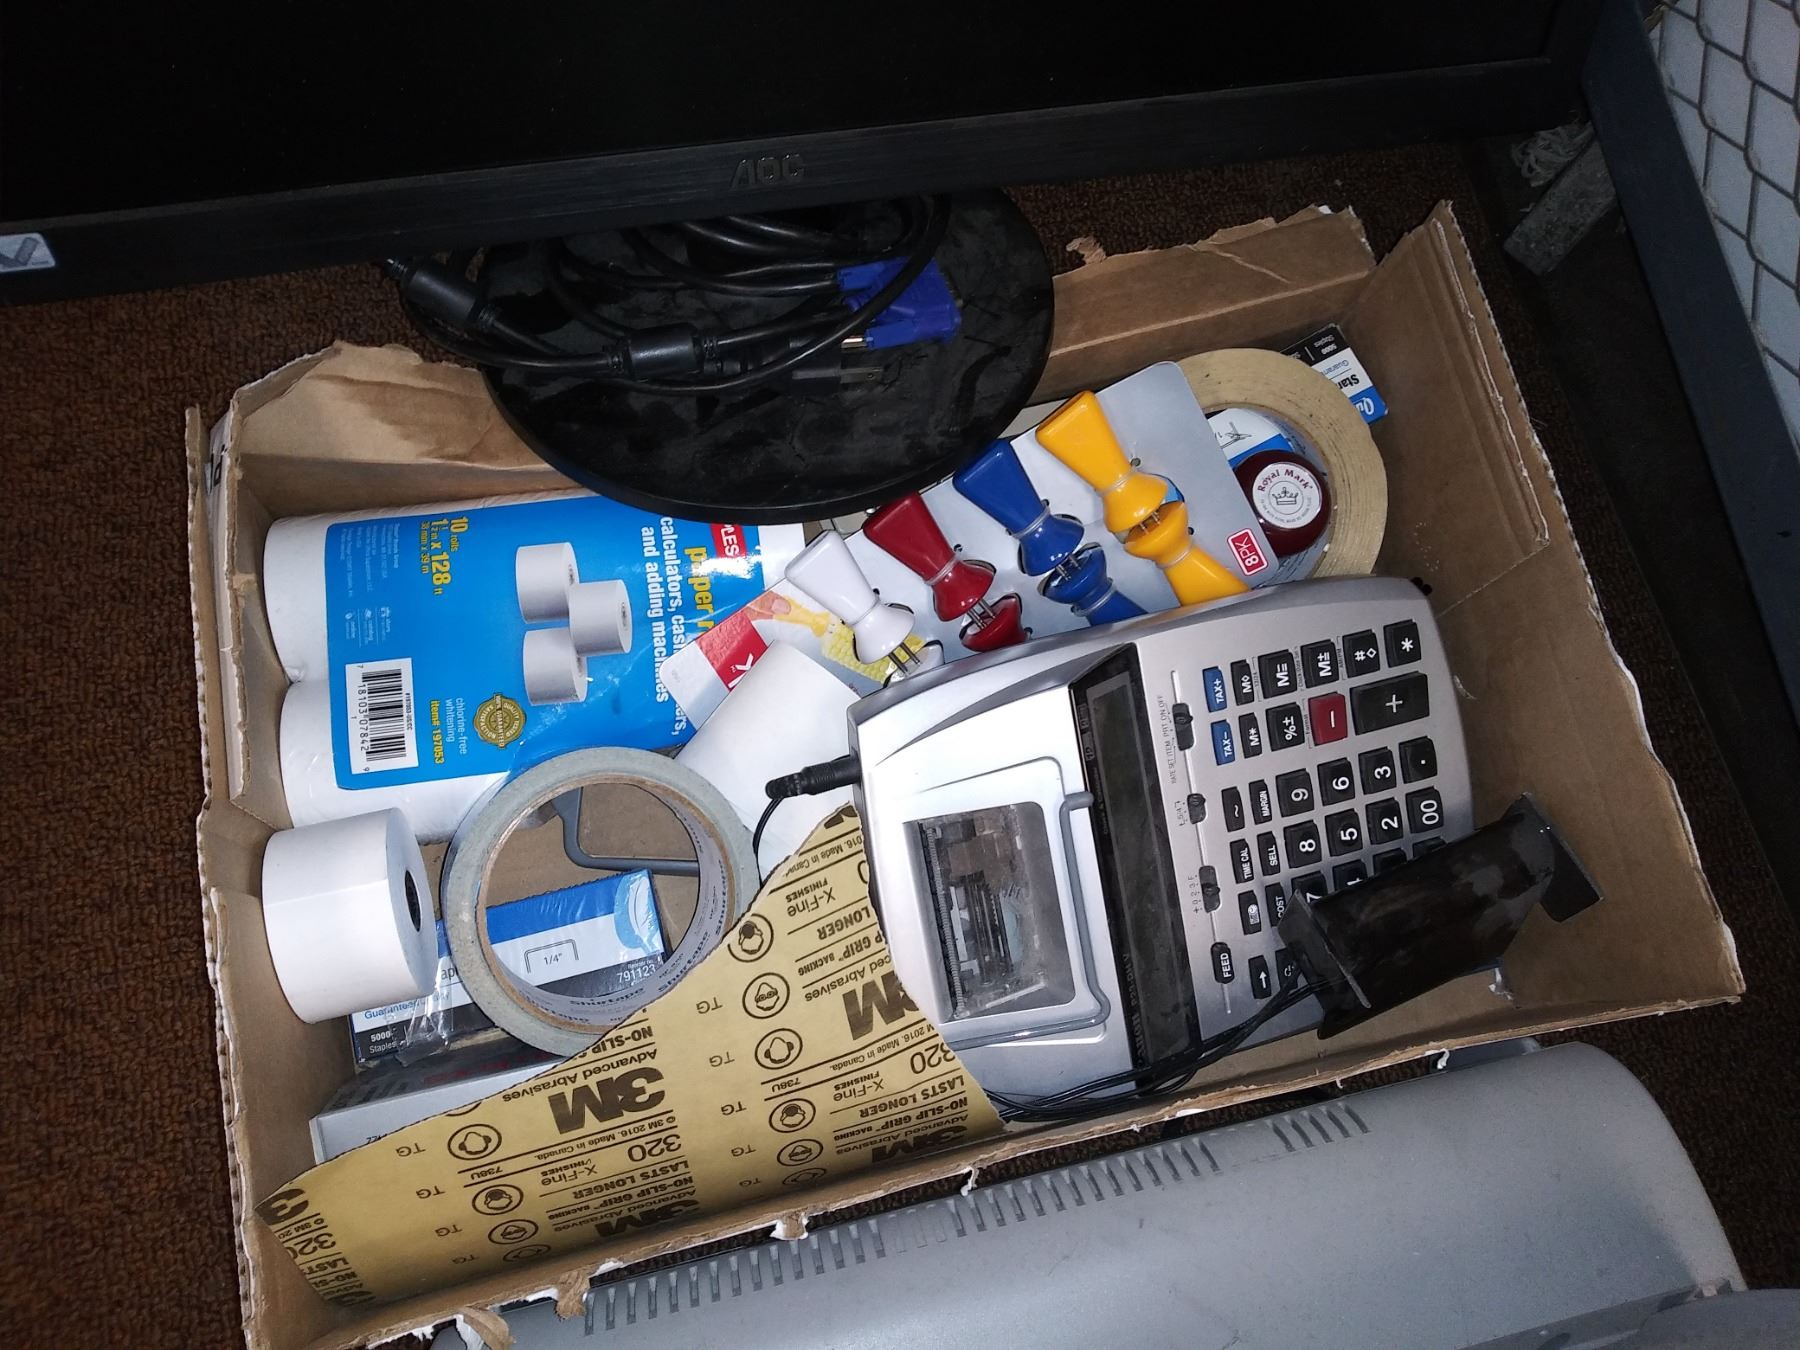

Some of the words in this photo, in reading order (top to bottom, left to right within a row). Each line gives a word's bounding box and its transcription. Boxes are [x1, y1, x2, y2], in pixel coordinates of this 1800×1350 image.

[729, 153, 804, 190] AOC
[1354, 397, 1375, 415] Qu
[1257, 469, 1280, 492] Royal
[1284, 468, 1310, 489] Mark
[450, 517, 469, 533] 10
[641, 526, 659, 557] and
[1234, 536, 1260, 567] 8PK
[431, 551, 452, 585] 128
[660, 516, 683, 612] calculators,
[645, 561, 665, 618] adding
[357, 683, 368, 715] 18103
[1213, 678, 1225, 704] TAX+
[430, 700, 441, 726] item#
[445, 698, 457, 742] whitening
[358, 719, 370, 752] 07842
[455, 697, 469, 755] chlorine-free
[432, 729, 445, 764] 197053
[1332, 777, 1350, 790] 6
[1374, 766, 1391, 779] 3
[1259, 790, 1270, 817] MARGIN
[1291, 788, 1308, 802] 9
[1381, 816, 1399, 830] 2
[1420, 800, 1439, 825] 00
[844, 836, 863, 849] 016.
[1299, 839, 1316, 852] 8
[1340, 828, 1358, 841] 5
[811, 854, 820, 863] in
[821, 844, 844, 859] Made
[1240, 847, 1249, 862] CAL
[1267, 845, 1278, 866] SELL
[785, 878, 829, 903] FINISHES
[787, 886, 837, 917] X-Fine
[1306, 892, 1322, 903] 7
[817, 905, 871, 940] LONGER
[658, 931, 709, 993] Shurtape
[798, 952, 835, 976] BACKING
[869, 955, 892, 974] ced
[1220, 952, 1232, 978] FEED
[616, 964, 657, 983] 791123
[804, 966, 866, 1002] Abrasives
[570, 986, 644, 1006] Shurtape
[696, 996, 723, 1014] TG
[842, 970, 919, 1040] M
[369, 1039, 397, 1054] Staples
[592, 1025, 654, 1055] NO-SLIP
[877, 1038, 900, 1055] Made
[902, 1029, 925, 1043] 2016.
[582, 1048, 658, 1081] Advanced
[709, 1051, 735, 1067] TG
[830, 1054, 866, 1071] Canada.
[867, 1050, 875, 1059] in
[910, 1042, 956, 1075] 320
[502, 1072, 578, 1102] Abrasives
[771, 1077, 802, 1092] 738U
[833, 1078, 885, 1102] X-Fine
[834, 1070, 880, 1091] FINISHES
[921, 1074, 965, 1100] LASTS
[547, 1067, 665, 1135] 3M
[721, 1101, 747, 1116] TG
[859, 1093, 918, 1118] LONGER
[916, 1096, 968, 1120] NO-SLIP
[618, 1125, 647, 1138] 2016.
[648, 1118, 665, 1130] 3M
[834, 1125, 873, 1142] BACKING
[905, 1114, 969, 1137] Advanced
[395, 1142, 426, 1157] TG
[576, 1140, 586, 1149] in
[588, 1133, 616, 1146] Made
[628, 1134, 682, 1162] 320
[731, 1144, 756, 1157] TG
[836, 1133, 900, 1155] Abrasives
[871, 1125, 968, 1163] 3M
[534, 1146, 575, 1161] Canada.
[470, 1166, 503, 1180] 738U
[541, 1163, 598, 1186] X-Fine
[639, 1160, 690, 1181] LASTS
[416, 1185, 446, 1199] TG
[572, 1175, 637, 1199] LONGER
[637, 1175, 694, 1197] NO-SLIP
[739, 1177, 763, 1187] TG
[627, 1189, 697, 1213] Advanced
[547, 1205, 590, 1221] BACKING
[554, 1209, 624, 1233] Abrasives
[595, 1199, 700, 1237] 3M
[435, 1224, 463, 1237] TG
[451, 1254, 480, 1264] TG
